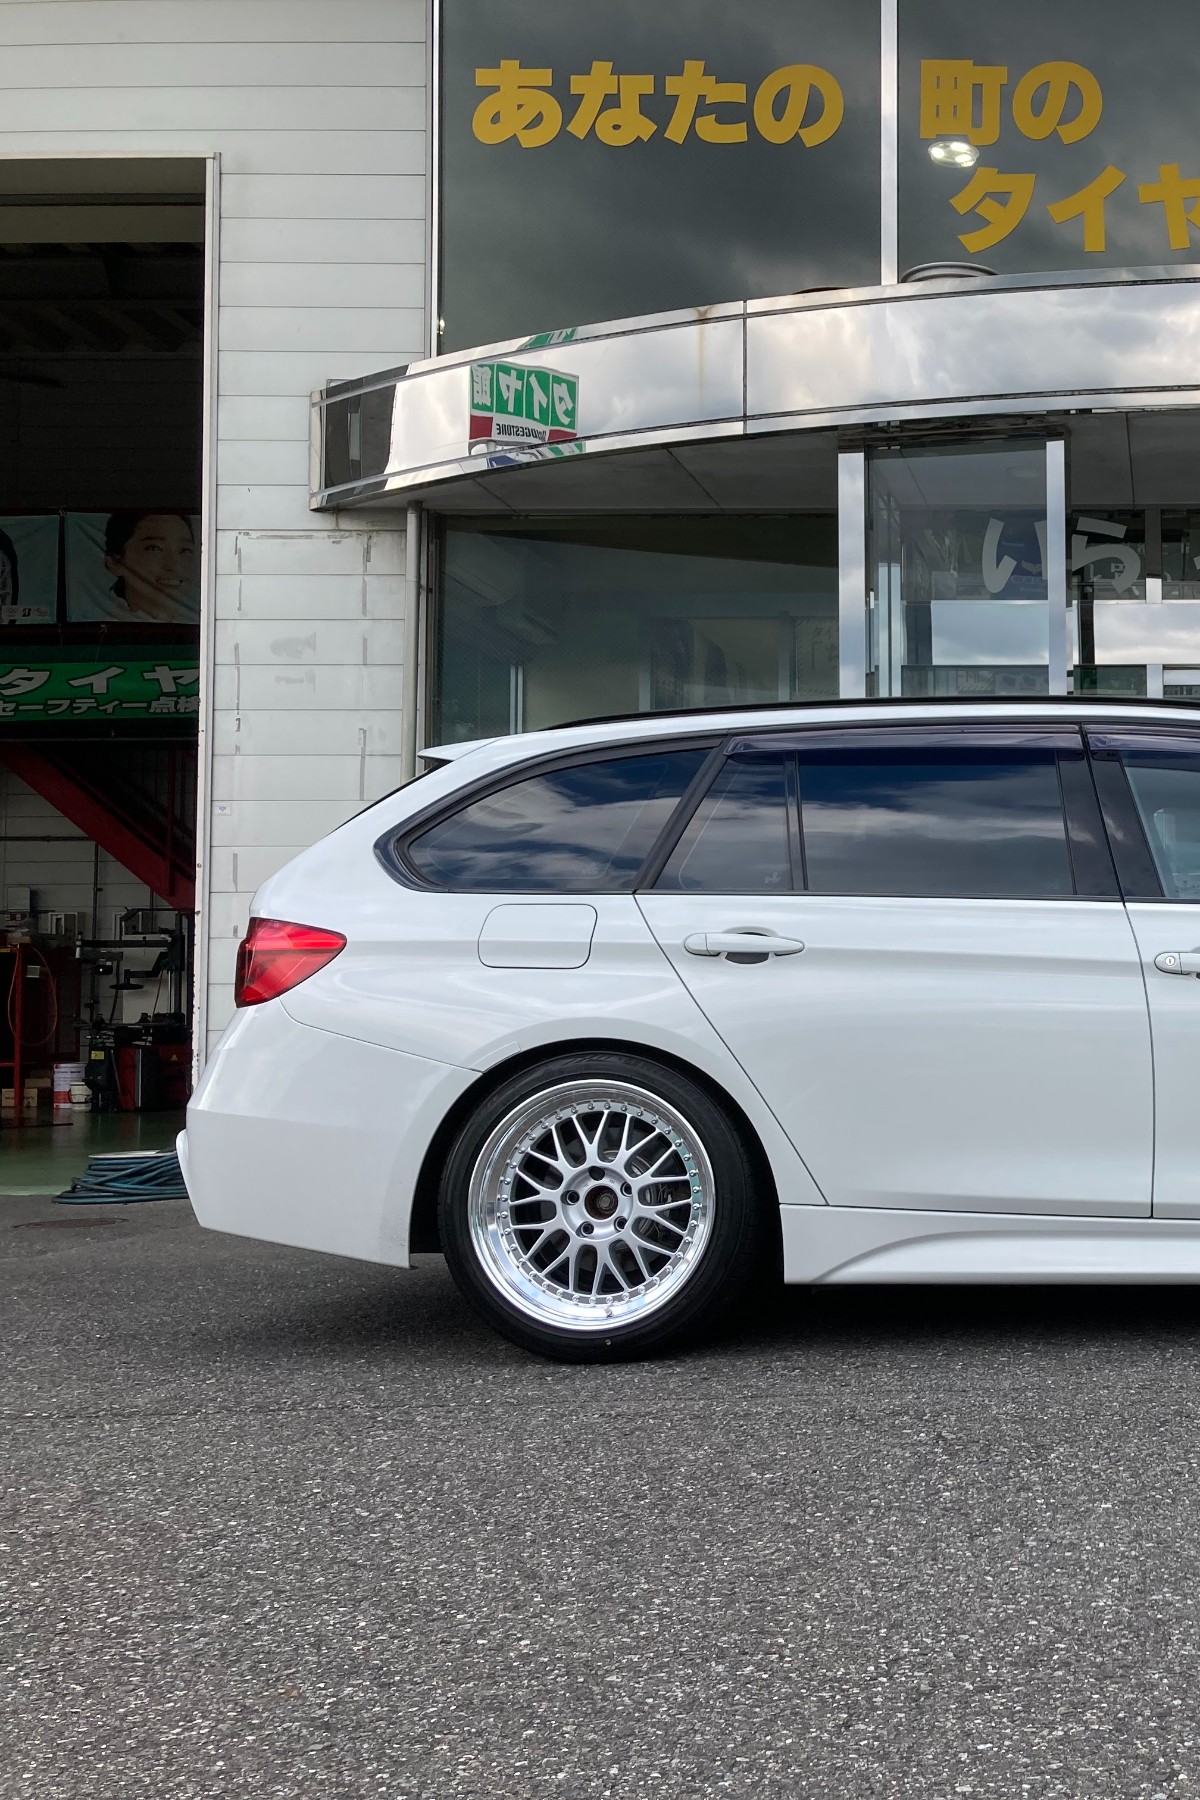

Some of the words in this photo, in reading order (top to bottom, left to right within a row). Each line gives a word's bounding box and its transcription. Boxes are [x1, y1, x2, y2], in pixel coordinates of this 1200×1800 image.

[472, 60, 844, 148] あなたの
[919, 59, 1103, 146] 町の
[0, 666, 199, 695] タイヤ
